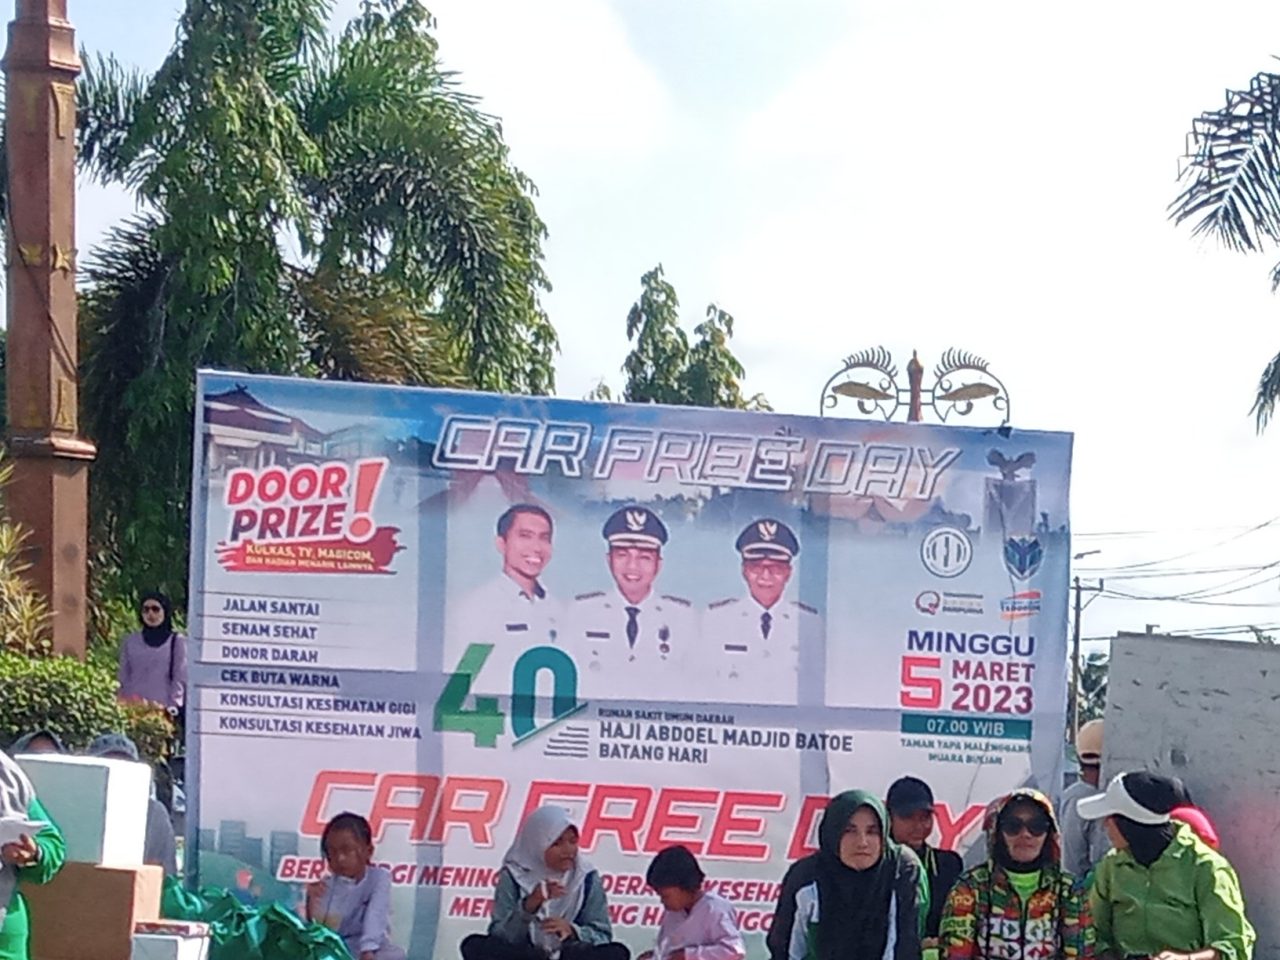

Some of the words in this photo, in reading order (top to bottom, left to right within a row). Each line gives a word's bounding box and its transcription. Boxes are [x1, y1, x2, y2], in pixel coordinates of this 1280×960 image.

[432, 414, 592, 478] CAR
[594, 425, 807, 492] FREE
[805, 441, 961, 501] DAY
[228, 466, 347, 505] DOOR
[223, 599, 267, 613] JALAN
[270, 601, 320, 616] SANTAI
[222, 622, 270, 637] SENAM
[273, 626, 318, 640] SEHAT
[222, 646, 268, 661] DONOR
[272, 649, 318, 663] DARAH
[907, 630, 1035, 657] MINGGU
[221, 669, 248, 683] CEK
[251, 671, 286, 685] BUTA
[288, 673, 340, 688] WARNA
[901, 655, 942, 709] 5
[952, 659, 1035, 683] MARET
[220, 693, 303, 710] KONSULTASI
[306, 698, 386, 714] KESEHATAN
[388, 701, 416, 715] GIGI
[951, 683, 1033, 714] 2023
[219, 717, 302, 733] KONSULTASI
[305, 721, 384, 738] KESEHATAN
[387, 725, 422, 740] JIWA
[600, 721, 641, 740] HAJI
[645, 725, 718, 745] ABDOEL
[722, 729, 790, 749] MADJID
[795, 732, 854, 752] BATOE
[926, 718, 969, 734] 07.00
[973, 721, 1006, 737] WIB
[599, 743, 664, 761] BATANG
[668, 747, 708, 764] HARI
[300, 770, 505, 847] CAR
[511, 780, 784, 859] FREE
[787, 795, 988, 861] DY
